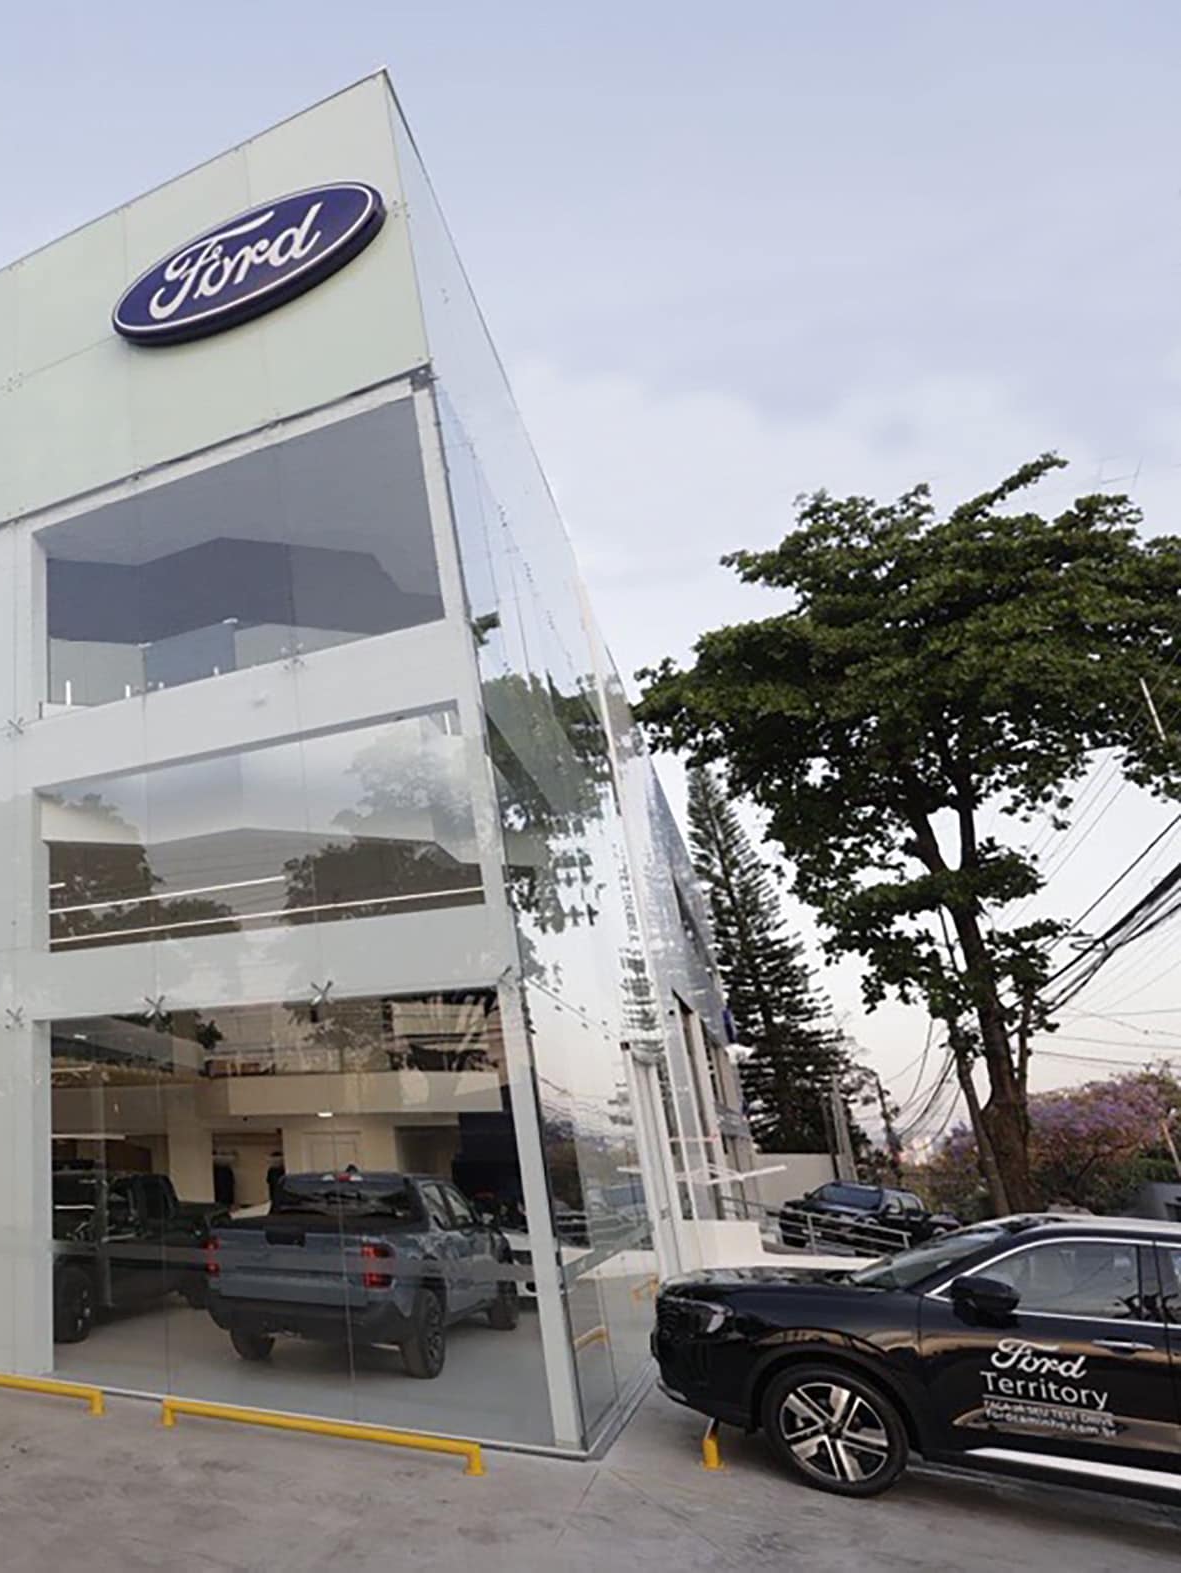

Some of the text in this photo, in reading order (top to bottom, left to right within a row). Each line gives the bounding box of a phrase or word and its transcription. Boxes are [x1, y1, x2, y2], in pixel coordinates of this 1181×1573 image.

[149, 202, 323, 319] Ford
[990, 1338, 1087, 1379] Ford
[980, 1371, 1108, 1410] Territory
